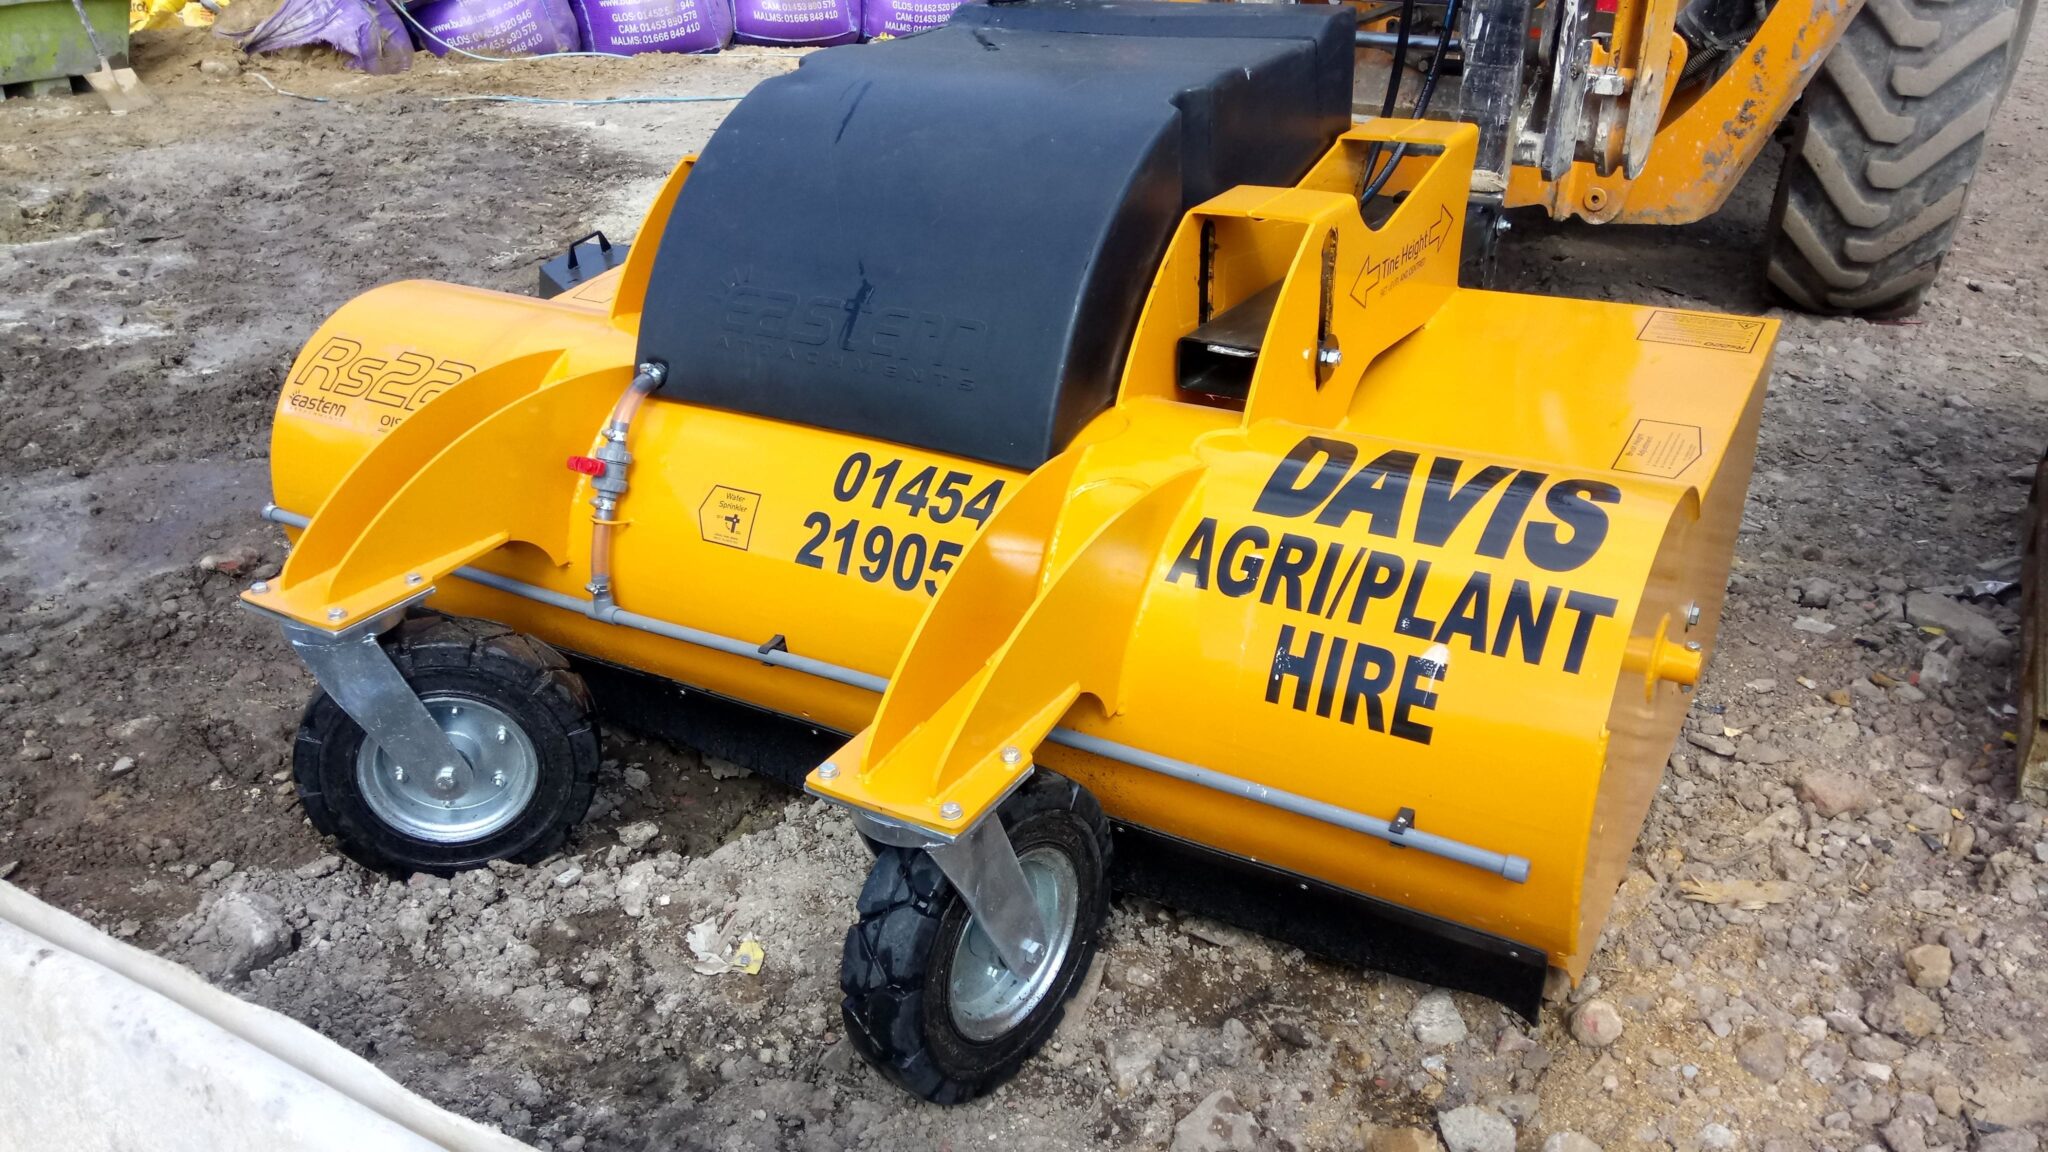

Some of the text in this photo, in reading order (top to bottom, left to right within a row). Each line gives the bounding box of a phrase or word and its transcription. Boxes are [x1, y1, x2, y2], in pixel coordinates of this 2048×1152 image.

[611, 12, 636, 22] GLOS:
[637, 7, 664, 20] 01452
[753, 10, 838, 24] MALMS: 01666 848 410
[892, 0, 914, 12] GLOS:
[914, 3, 937, 13] 01452
[937, 3, 950, 12] 520
[895, 12, 950, 24] CAM: 01453 890
[502, 17, 516, 32] 520
[516, 8, 532, 23] 946
[522, 21, 538, 36] 578
[618, 24, 639, 34] CAM:
[640, 20, 667, 33] 01453
[683, 9, 698, 21] 578
[884, 21, 913, 32] MALMS:
[527, 33, 543, 48] 410
[610, 22, 701, 46] MALMS: 01666 848 410
[1382, 230, 1428, 279] Tine Height
[291, 393, 347, 417] eastern
[726, 492, 745, 502] Water
[833, 452, 1006, 531] 01454
[718, 500, 747, 513] Sprinkler
[1251, 435, 1622, 573] DAVIS
[794, 511, 964, 598] 21905
[1164, 516, 1619, 675] AGRI/PLANT
[1264, 624, 1450, 746] HIRE
